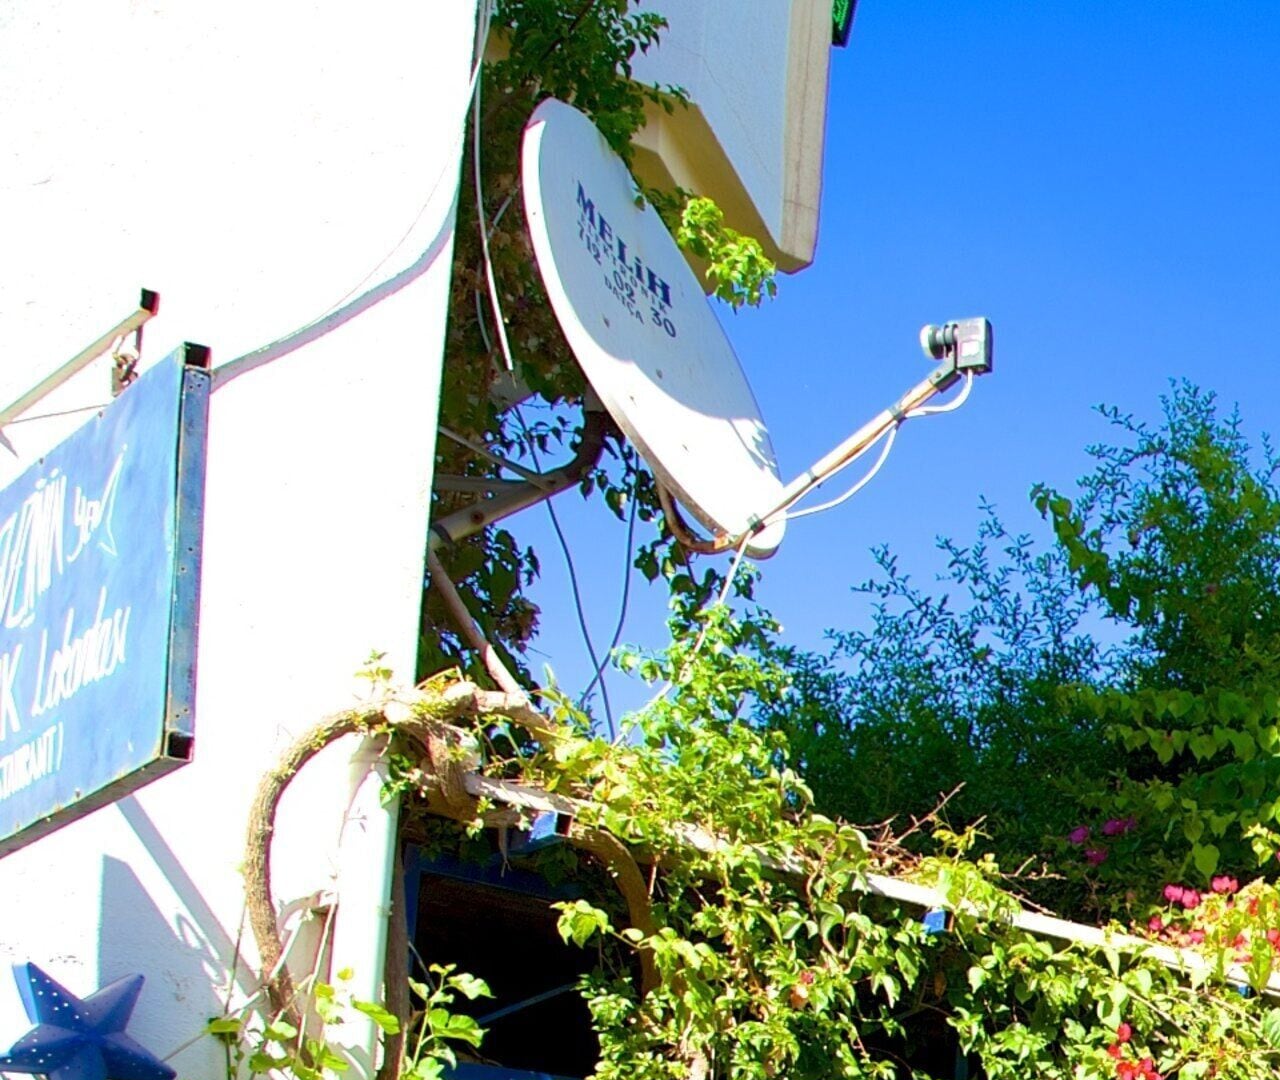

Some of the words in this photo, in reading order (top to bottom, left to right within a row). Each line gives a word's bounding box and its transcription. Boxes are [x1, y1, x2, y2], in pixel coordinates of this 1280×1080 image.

[577, 220, 602, 266] 712
[612, 269, 636, 304] 02
[649, 306, 677, 338] 30
